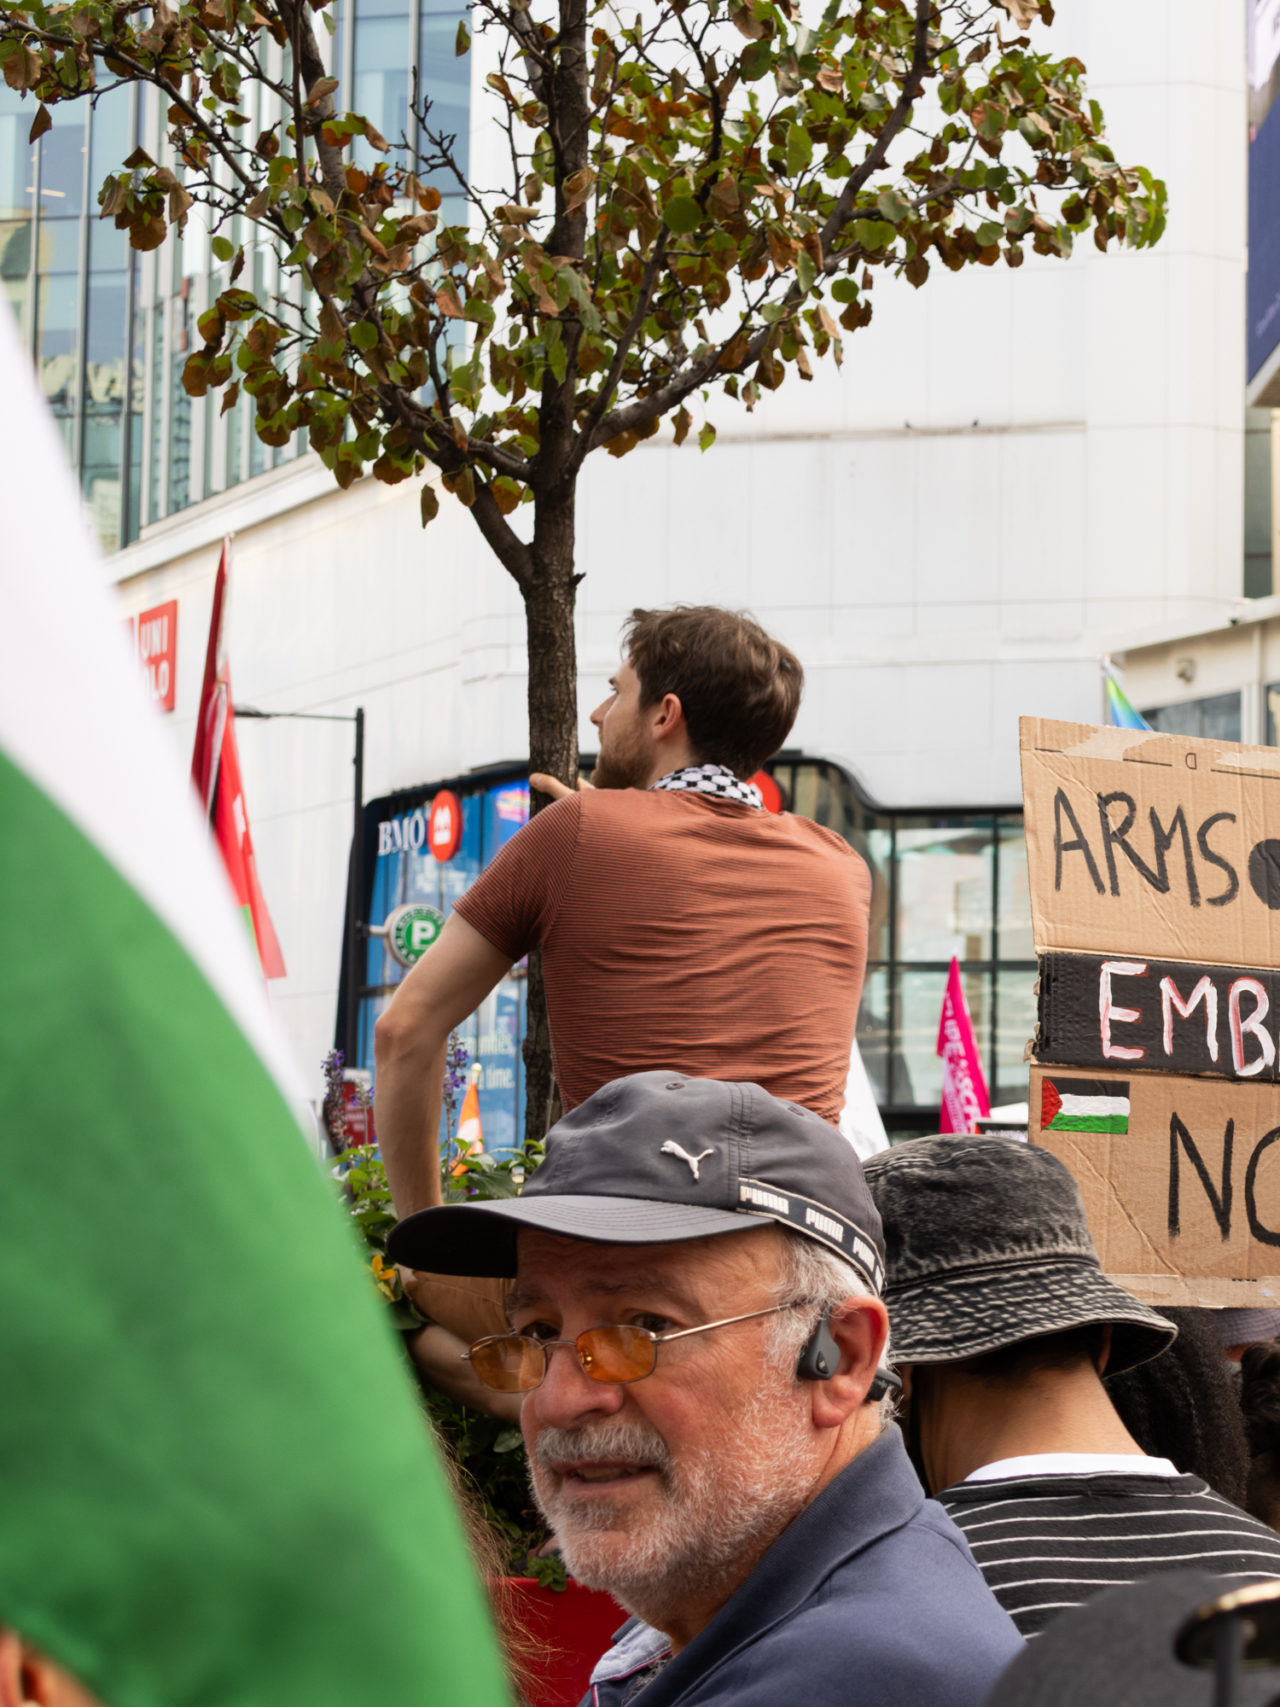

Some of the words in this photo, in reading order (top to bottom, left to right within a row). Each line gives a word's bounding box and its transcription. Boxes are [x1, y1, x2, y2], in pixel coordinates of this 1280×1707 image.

[141, 614, 169, 660] UNI
[144, 660, 170, 701] LO
[378, 814, 425, 856] BMO
[1053, 786, 1240, 907] ARMS
[411, 919, 436, 950] P
[740, 1184, 790, 1216] PUMA
[805, 1206, 844, 1244] PUMA
